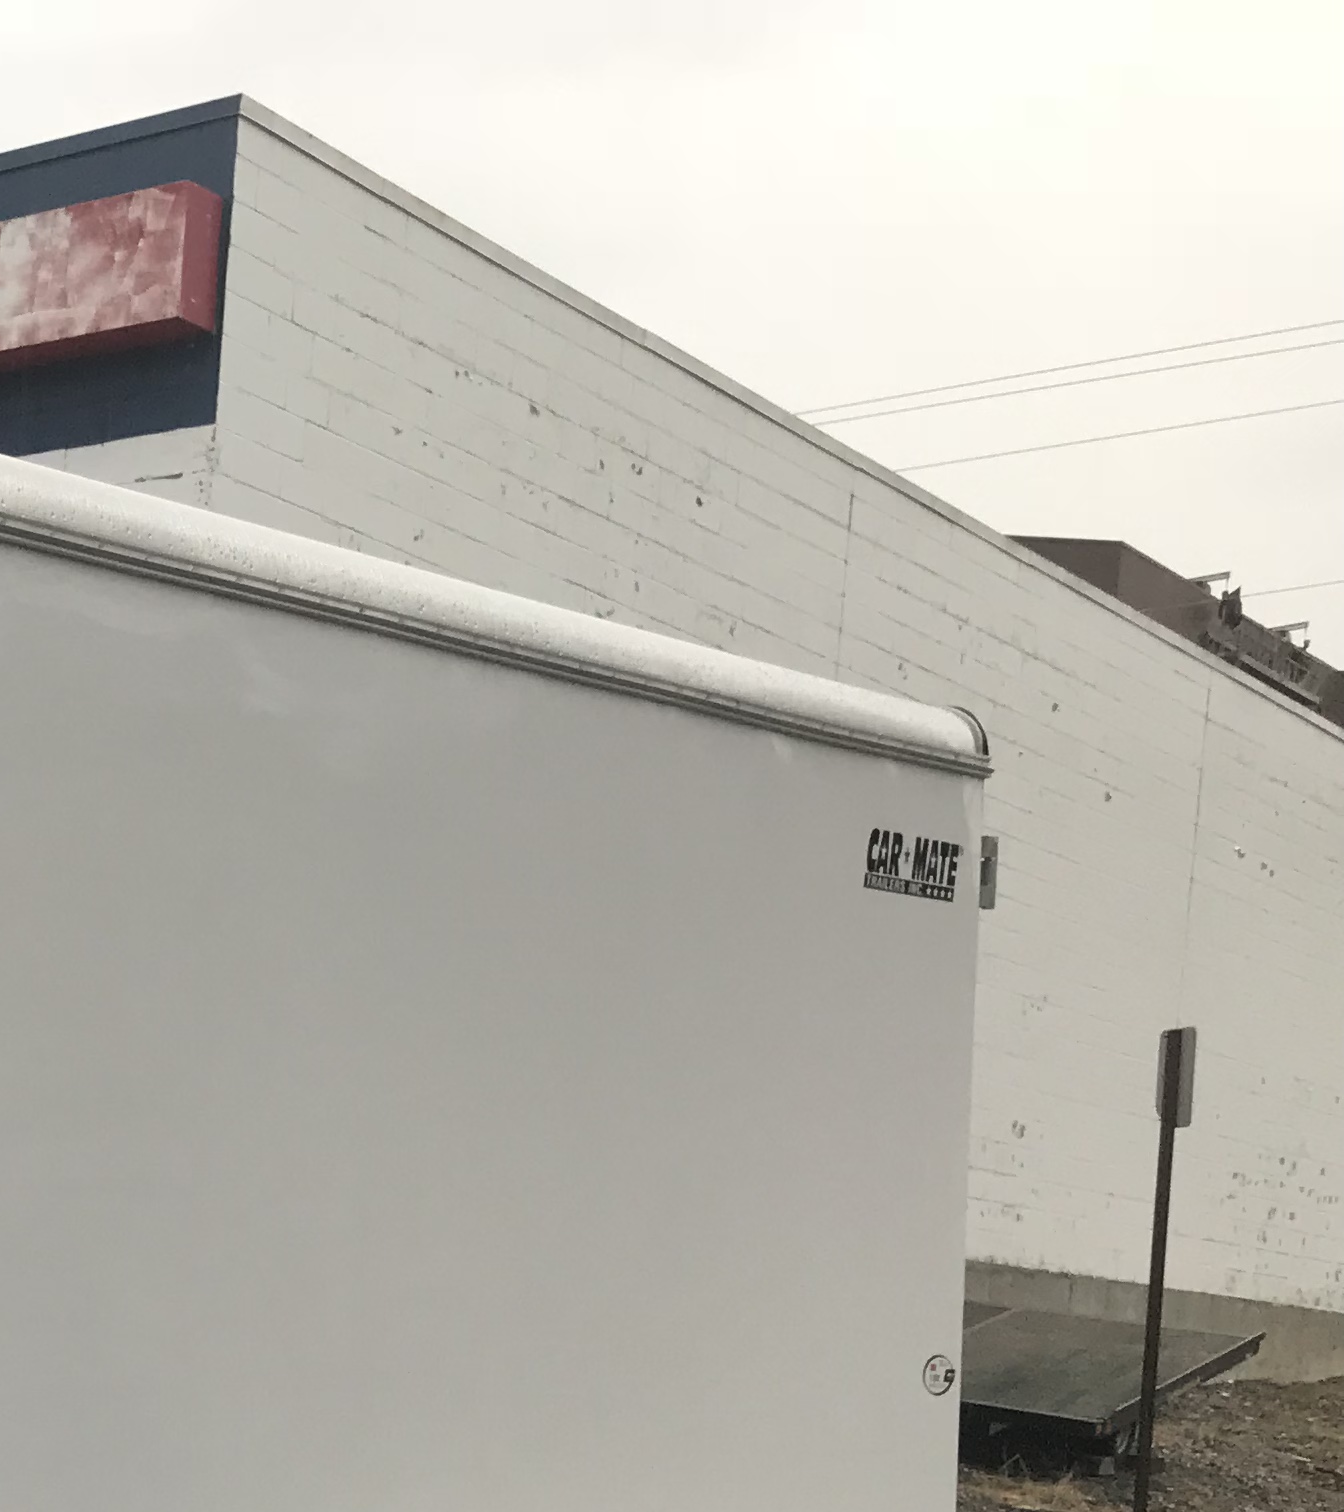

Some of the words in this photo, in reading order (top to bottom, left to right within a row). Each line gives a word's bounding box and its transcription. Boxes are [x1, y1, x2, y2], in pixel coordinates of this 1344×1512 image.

[866, 828, 904, 877] CAR
[911, 836, 960, 887] MATE
[866, 873, 906, 893] TRAILERS
